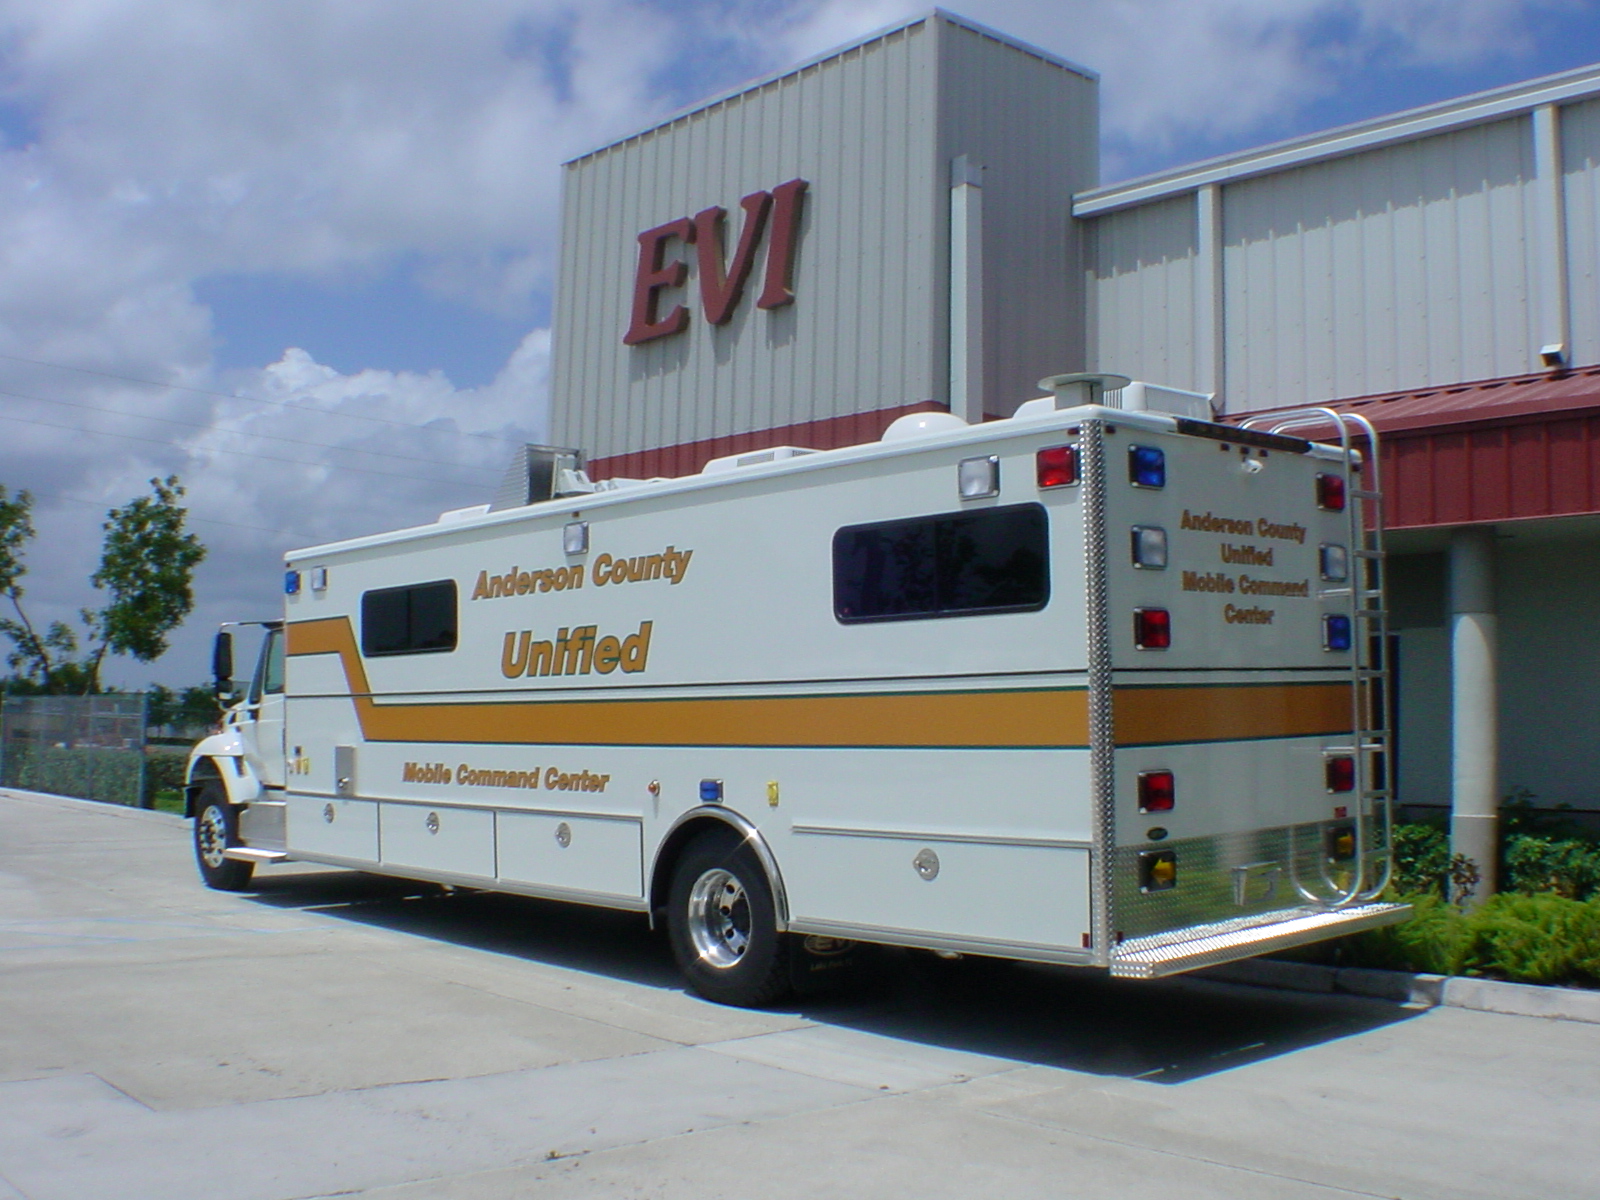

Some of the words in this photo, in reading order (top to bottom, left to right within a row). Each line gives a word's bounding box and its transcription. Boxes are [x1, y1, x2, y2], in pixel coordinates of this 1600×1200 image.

[623, 177, 810, 346] EVI
[1180, 509, 1254, 536] Anderson
[1257, 518, 1307, 544] County
[1220, 544, 1273, 567] Unified
[471, 564, 584, 601] Anderson
[592, 546, 694, 587] County
[1182, 571, 1235, 594] Mobile
[1238, 574, 1309, 598] Command
[1224, 603, 1275, 625] Center
[501, 620, 653, 679] Unified
[402, 762, 452, 784] Mobile
[456, 763, 541, 789] Command
[544, 766, 610, 793] Center
